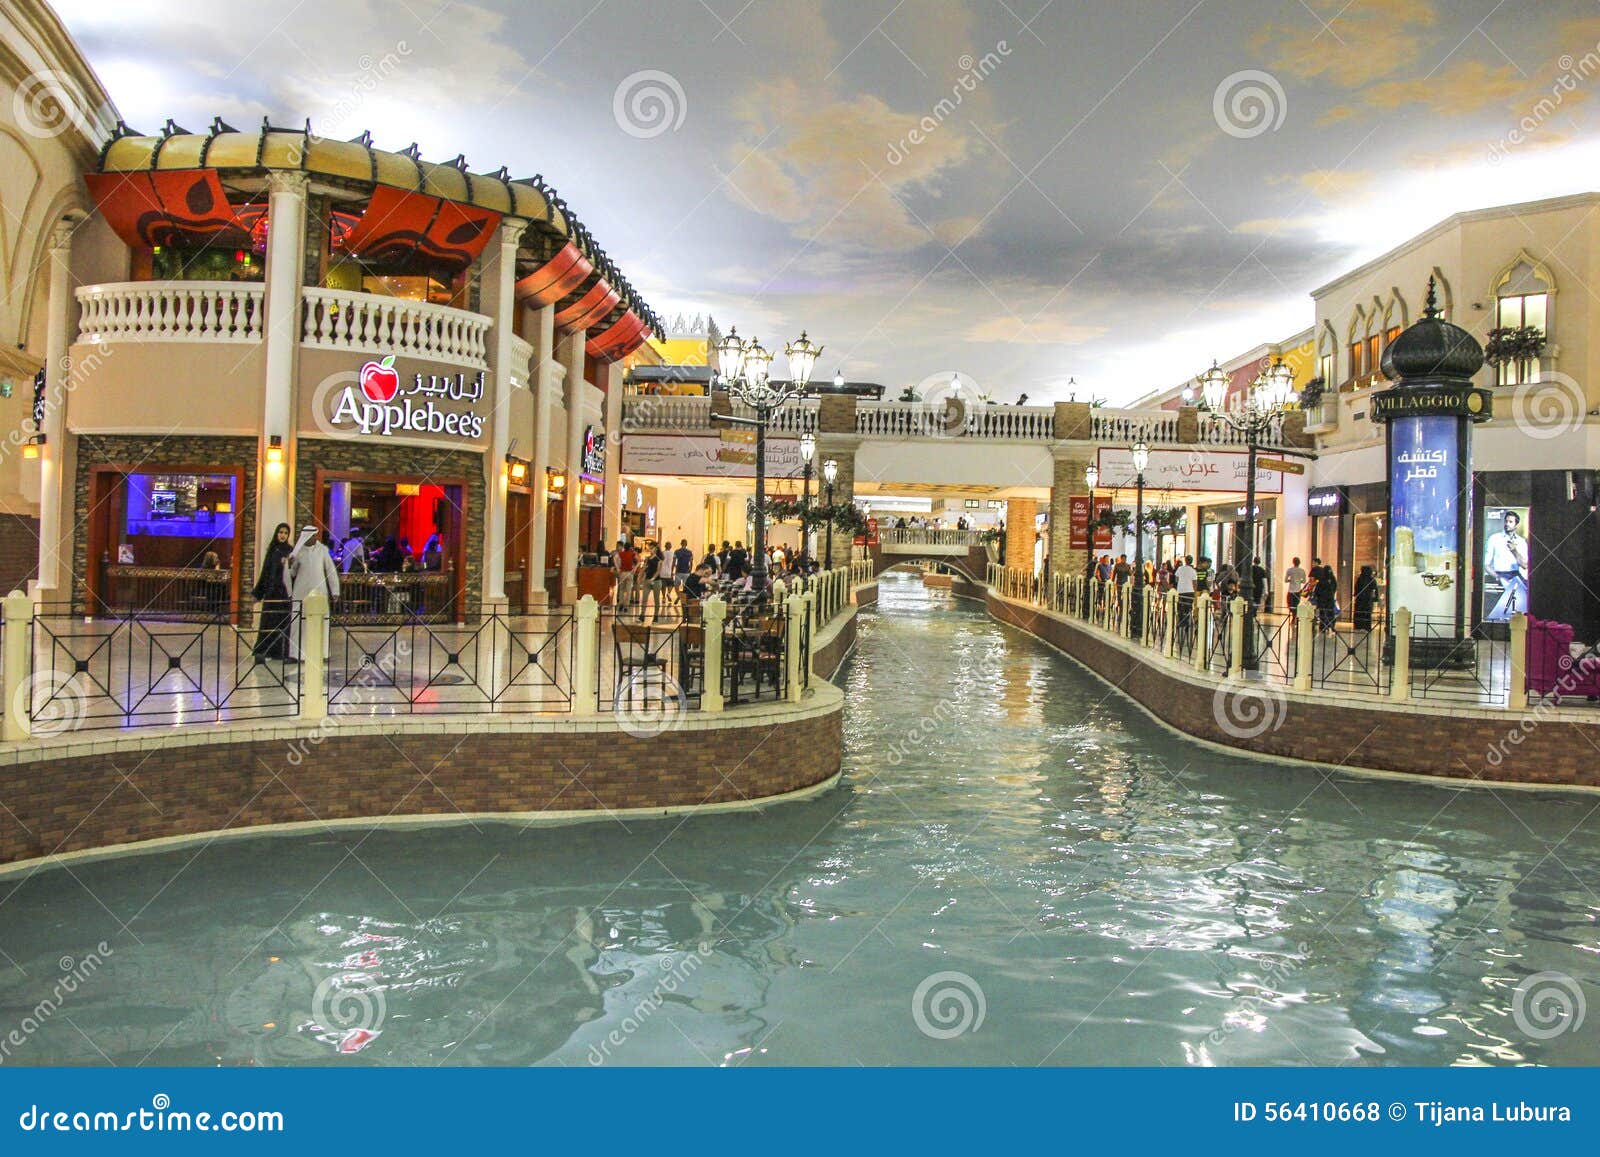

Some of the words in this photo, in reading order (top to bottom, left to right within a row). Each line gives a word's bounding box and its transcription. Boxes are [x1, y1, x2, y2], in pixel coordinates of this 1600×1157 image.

[1380, 395, 1460, 409] VILLAGGIO
[331, 386, 485, 438] Applebee's
[1404, 466, 1438, 482] قطر
